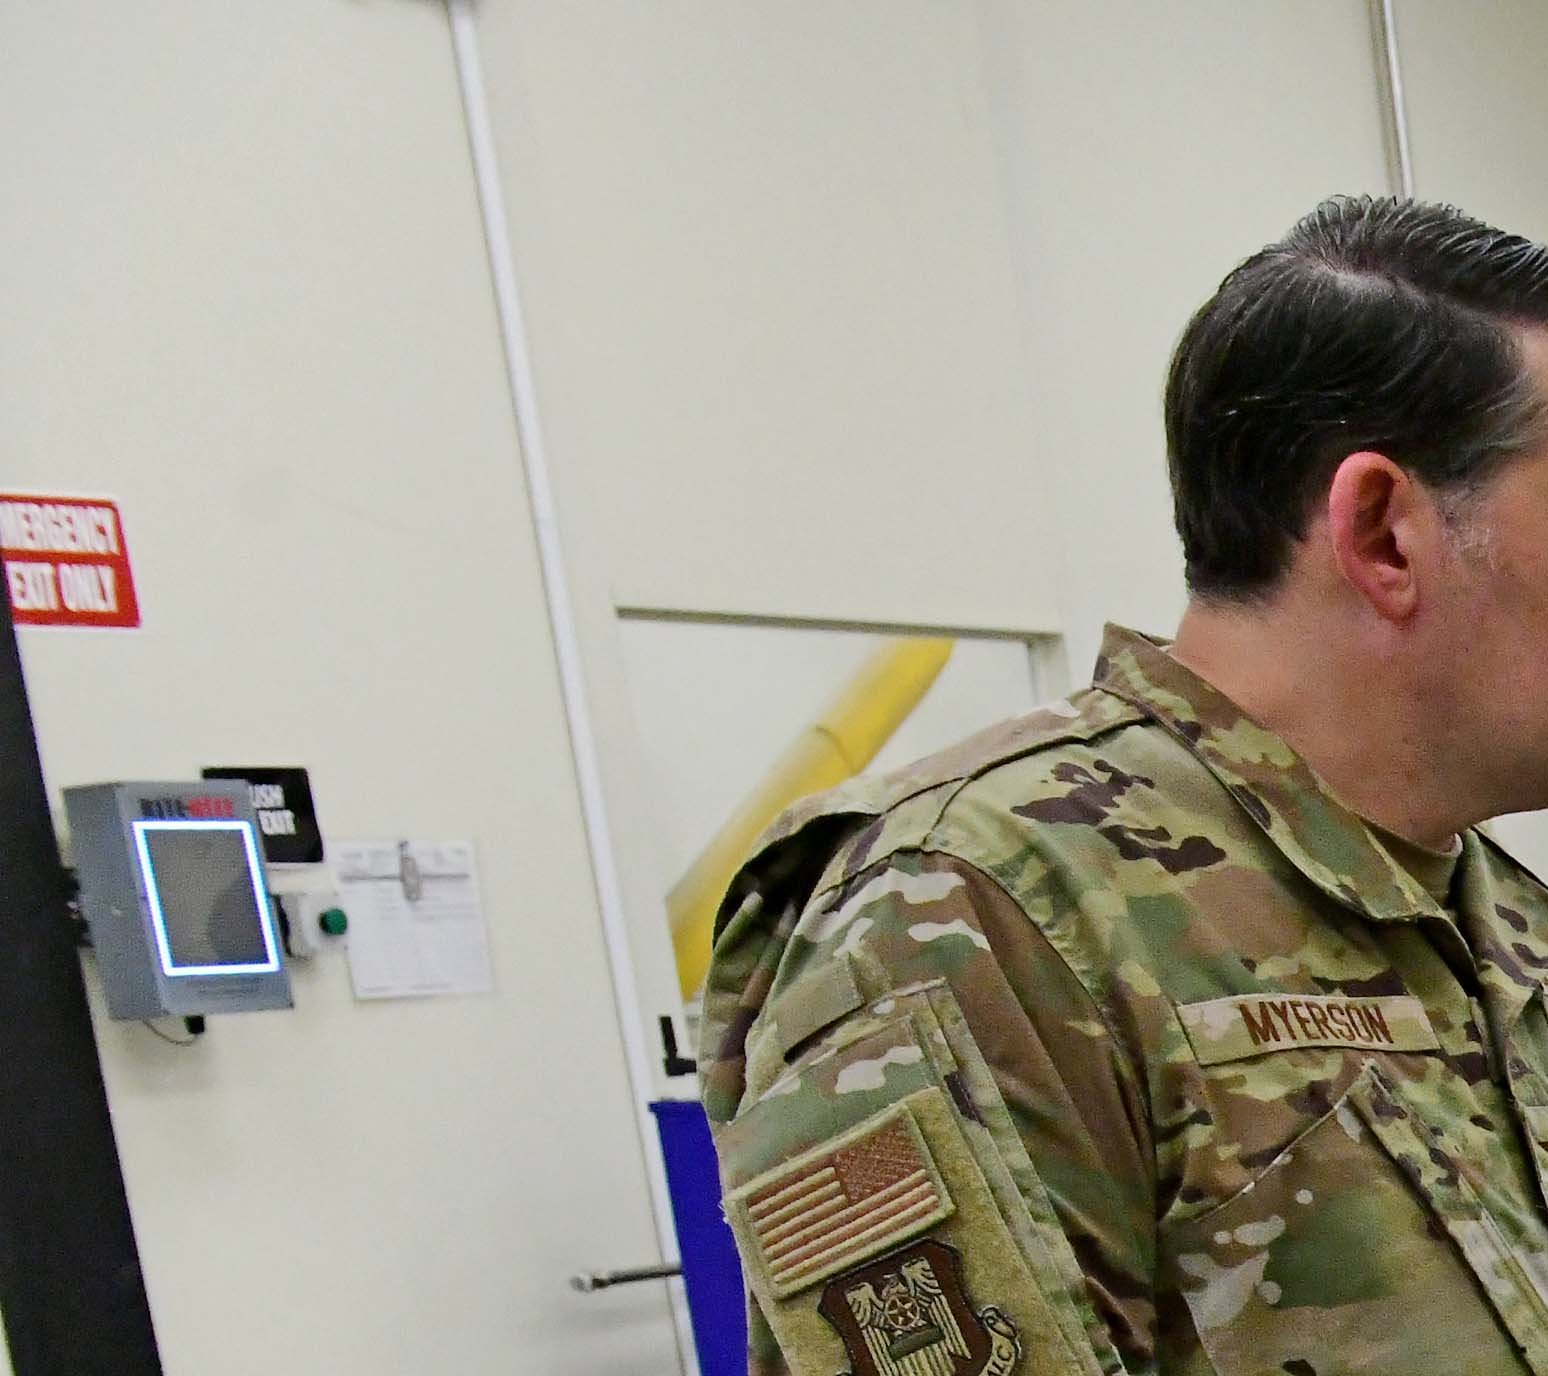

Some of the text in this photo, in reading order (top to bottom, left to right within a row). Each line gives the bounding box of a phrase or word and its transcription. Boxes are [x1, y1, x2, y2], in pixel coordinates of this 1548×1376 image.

[5, 560, 118, 613] EXIT ONLY
[1239, 1001, 1395, 1046] MYERSON
